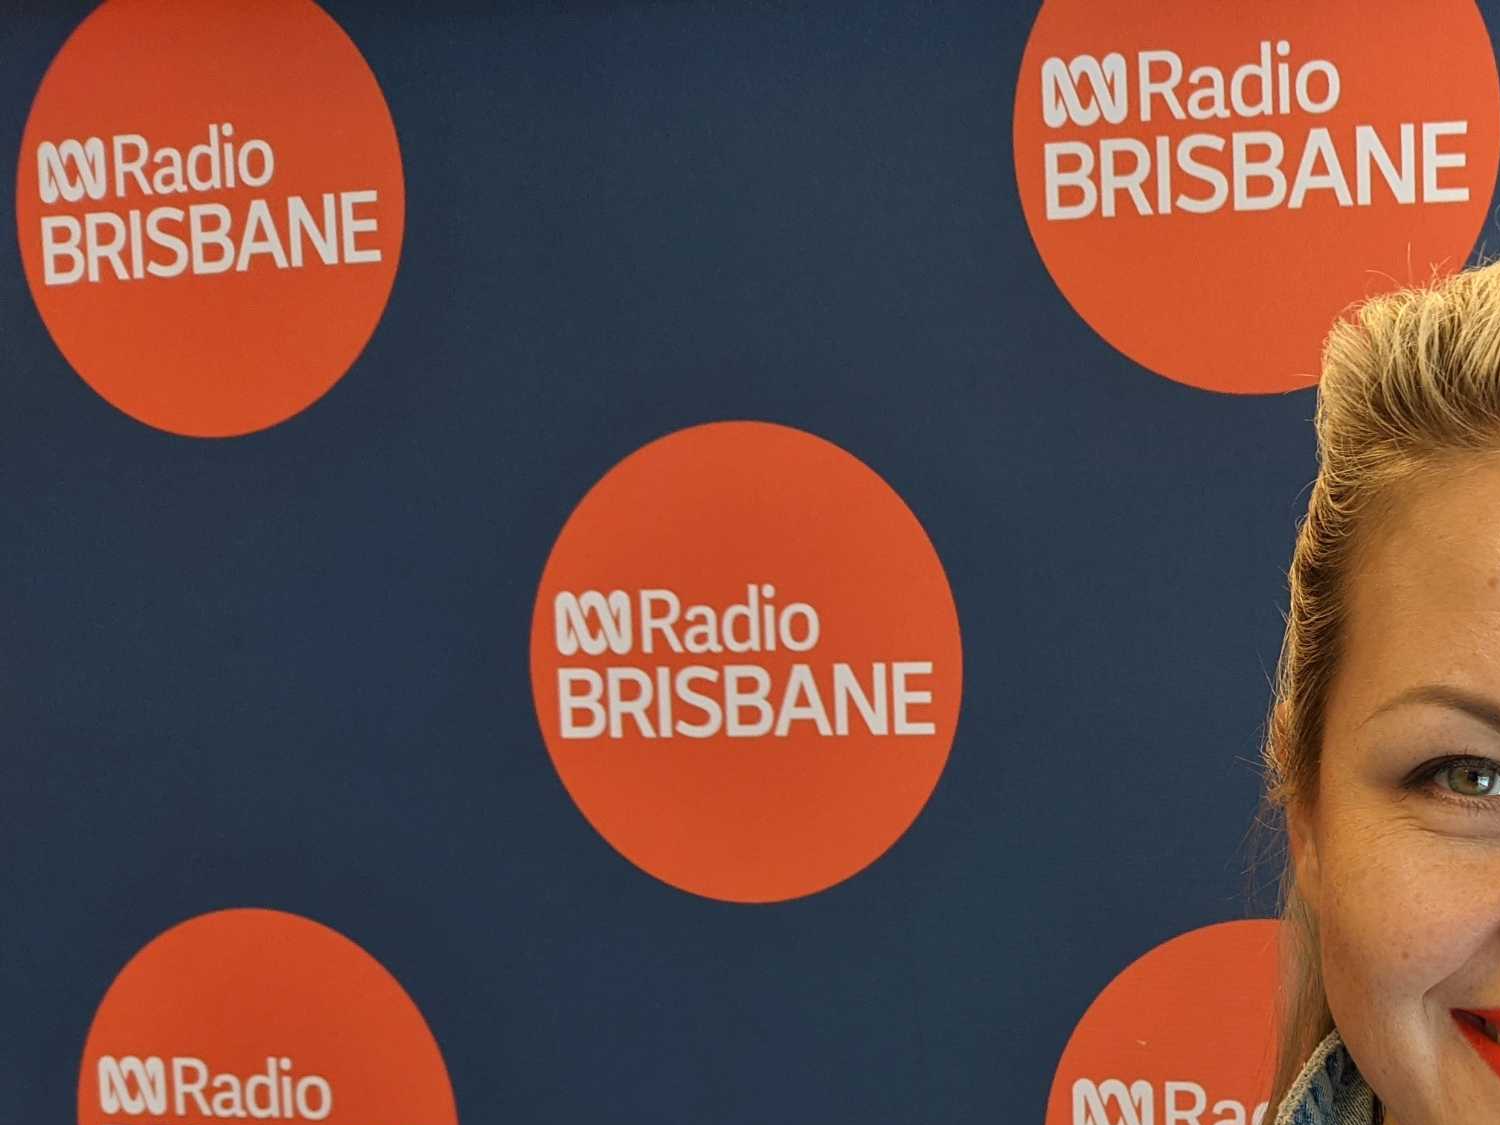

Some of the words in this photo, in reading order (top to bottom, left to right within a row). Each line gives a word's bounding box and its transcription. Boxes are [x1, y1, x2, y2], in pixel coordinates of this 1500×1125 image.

[1137, 40, 1341, 121] Radio
[113, 124, 275, 197] Radio
[1043, 121, 1471, 220] BRISBANE
[40, 190, 382, 285] BRISBANE
[639, 585, 819, 653] Radio
[558, 662, 936, 738] BRISBANE
[172, 1057, 331, 1119] Radio
